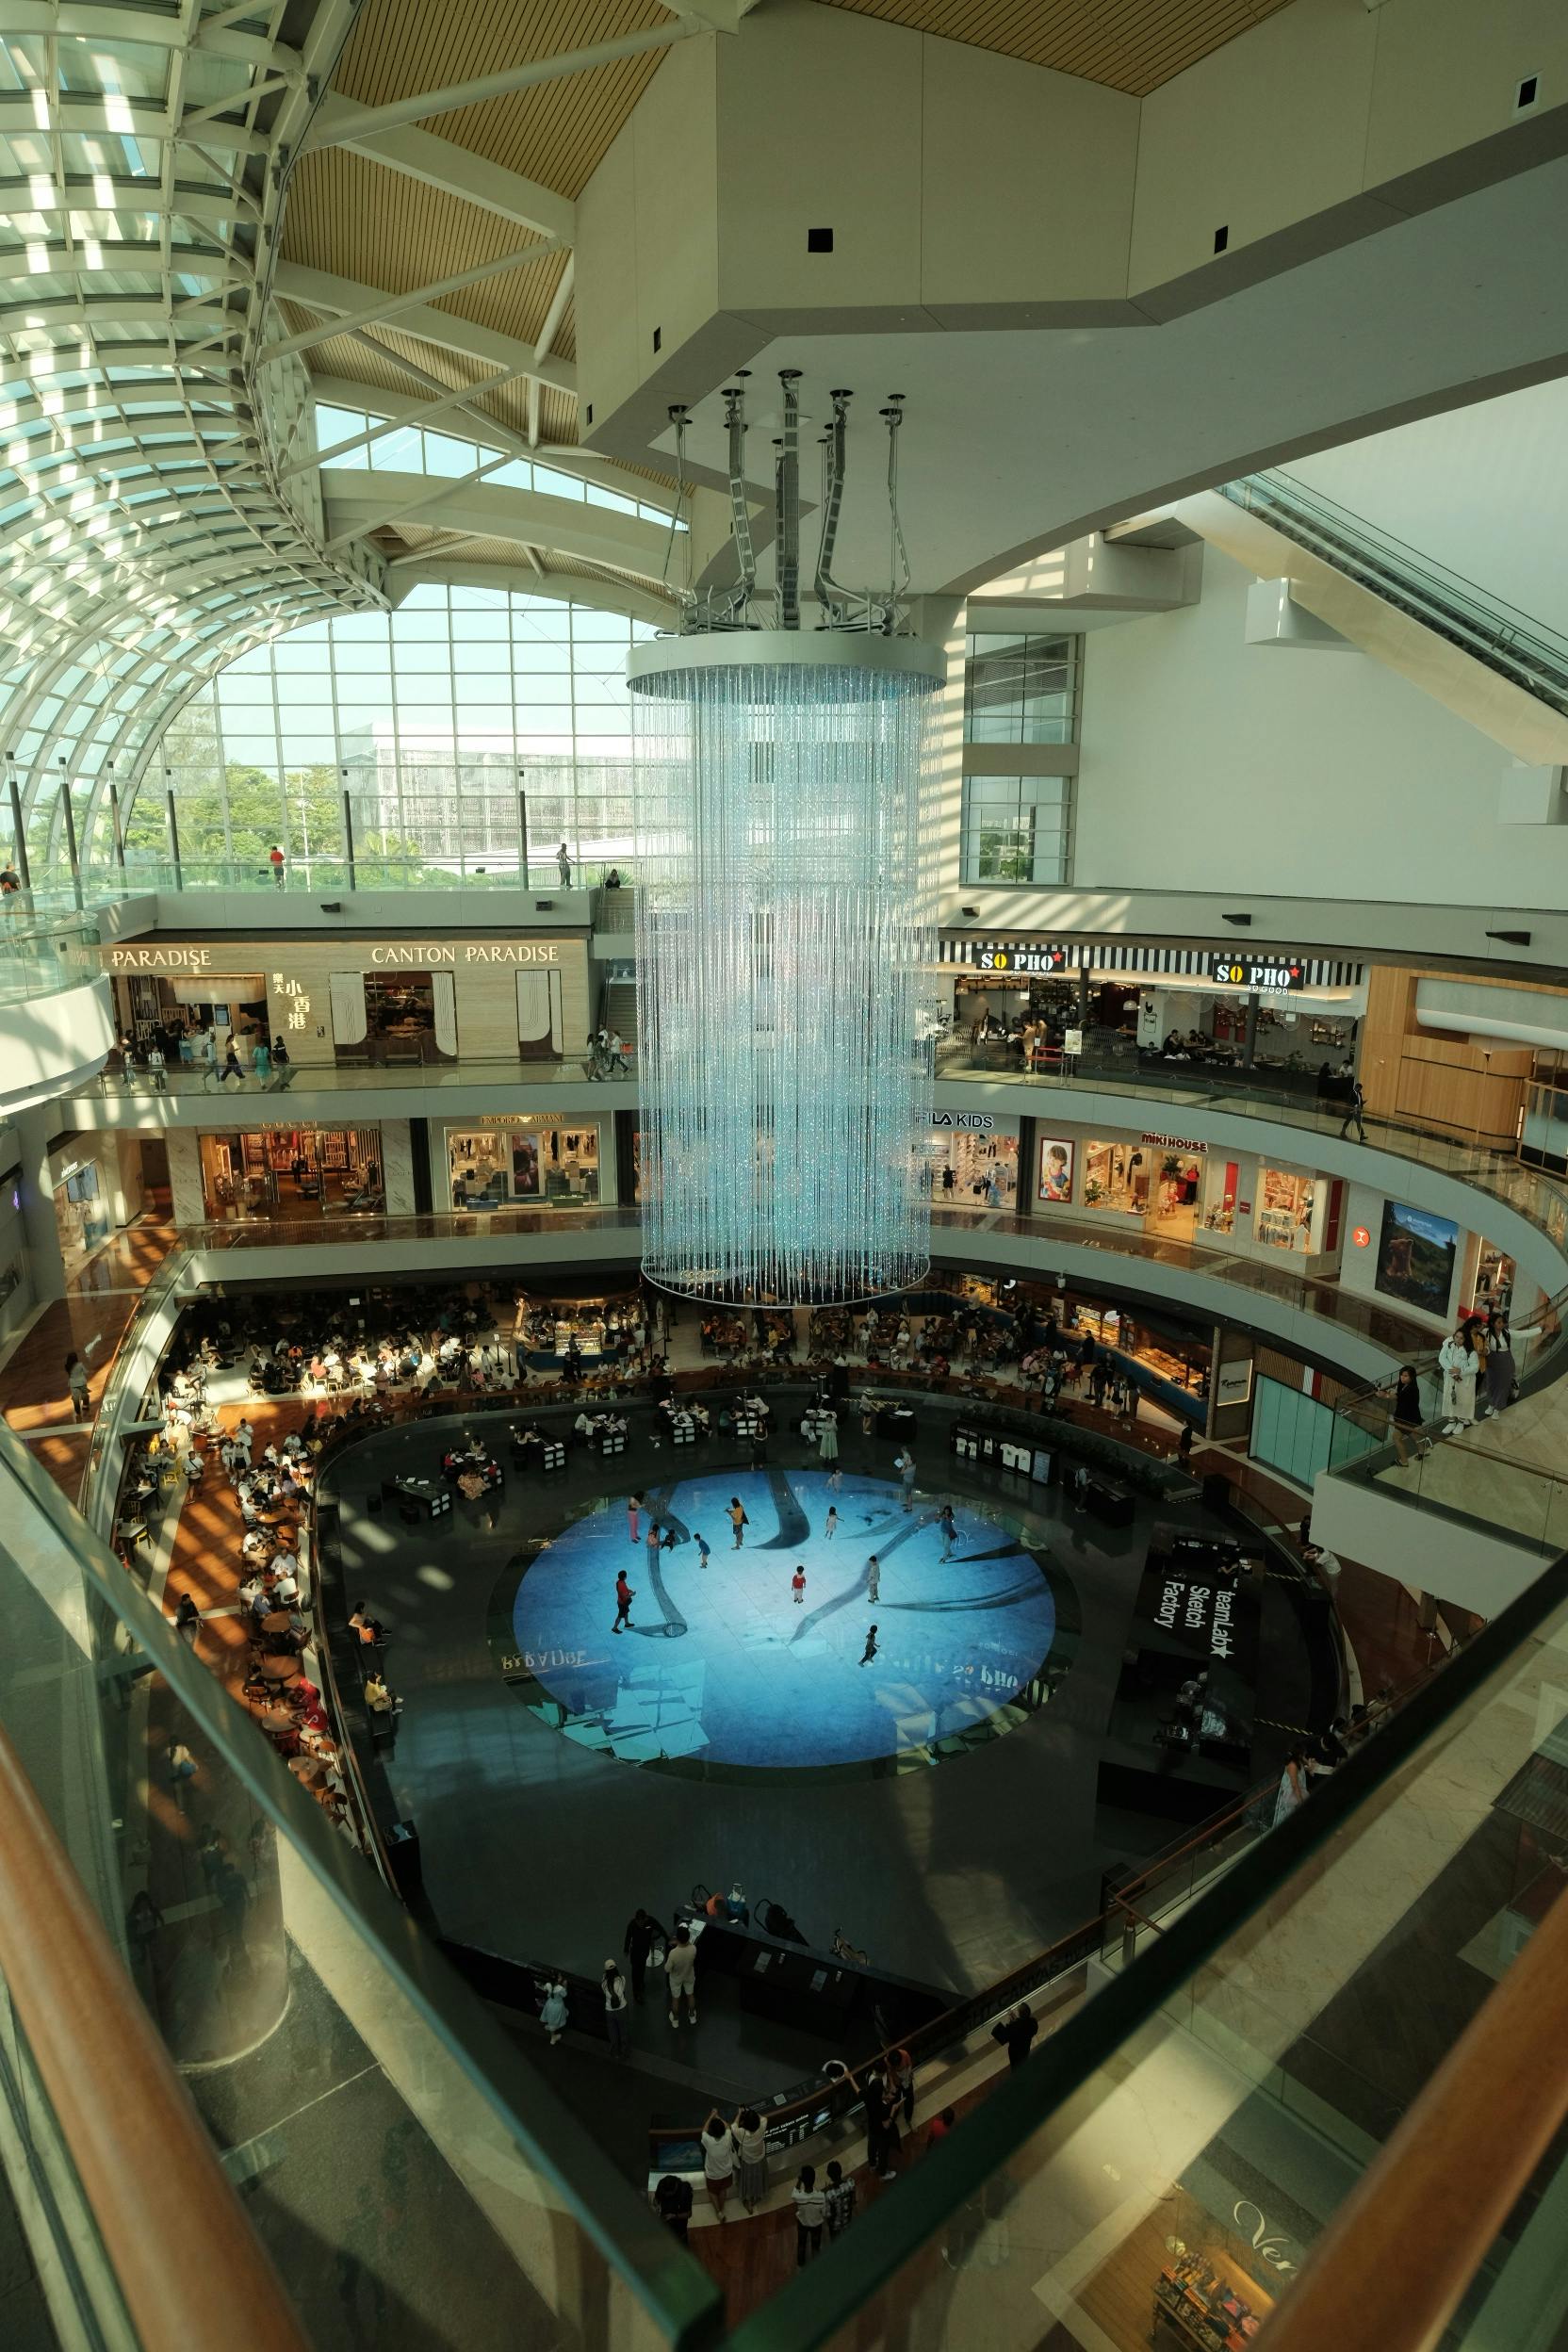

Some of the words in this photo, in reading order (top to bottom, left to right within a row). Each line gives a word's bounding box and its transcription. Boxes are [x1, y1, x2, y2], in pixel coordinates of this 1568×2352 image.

[111, 949, 212, 967] PARADISE
[371, 947, 455, 964] CANTON
[466, 946, 559, 962] PARADISE
[981, 953, 1007, 970] SO
[1014, 954, 1054, 972] PHO
[1217, 964, 1243, 983] SO
[1250, 967, 1291, 988] PHO
[285, 979, 311, 1030] 小香港
[482, 1116, 519, 1125] EMPORIO
[531, 1114, 564, 1123] ARMANI
[956, 1114, 994, 1129] KIDS
[1153, 1580, 1185, 1629] Factory
[1184, 1585, 1211, 1628] Sketch
[1211, 1590, 1236, 1646] teamLab
